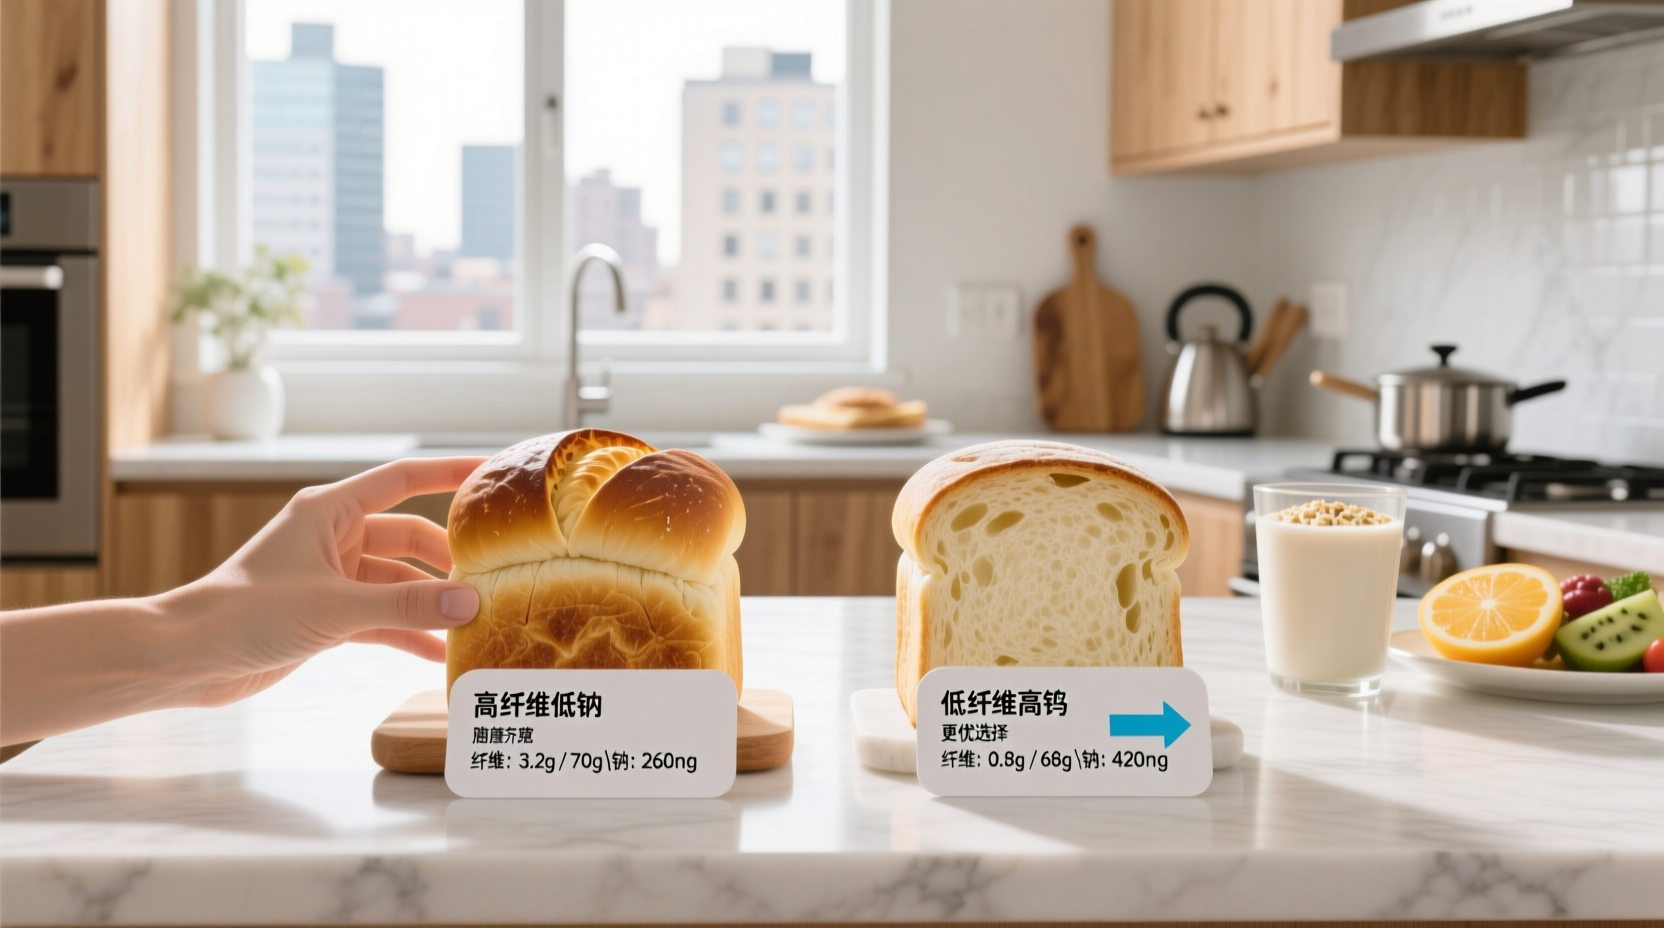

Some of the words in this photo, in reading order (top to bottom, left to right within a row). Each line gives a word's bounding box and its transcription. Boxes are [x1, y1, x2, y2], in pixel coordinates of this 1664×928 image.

[474, 691, 602, 718] 高纤维低钠
[942, 723, 1008, 742] 更优选择
[519, 752, 555, 773] 3.2g
[642, 752, 697, 773] 260ng
[988, 751, 1024, 772] 0.8g
[1112, 751, 1168, 772] 420ng
